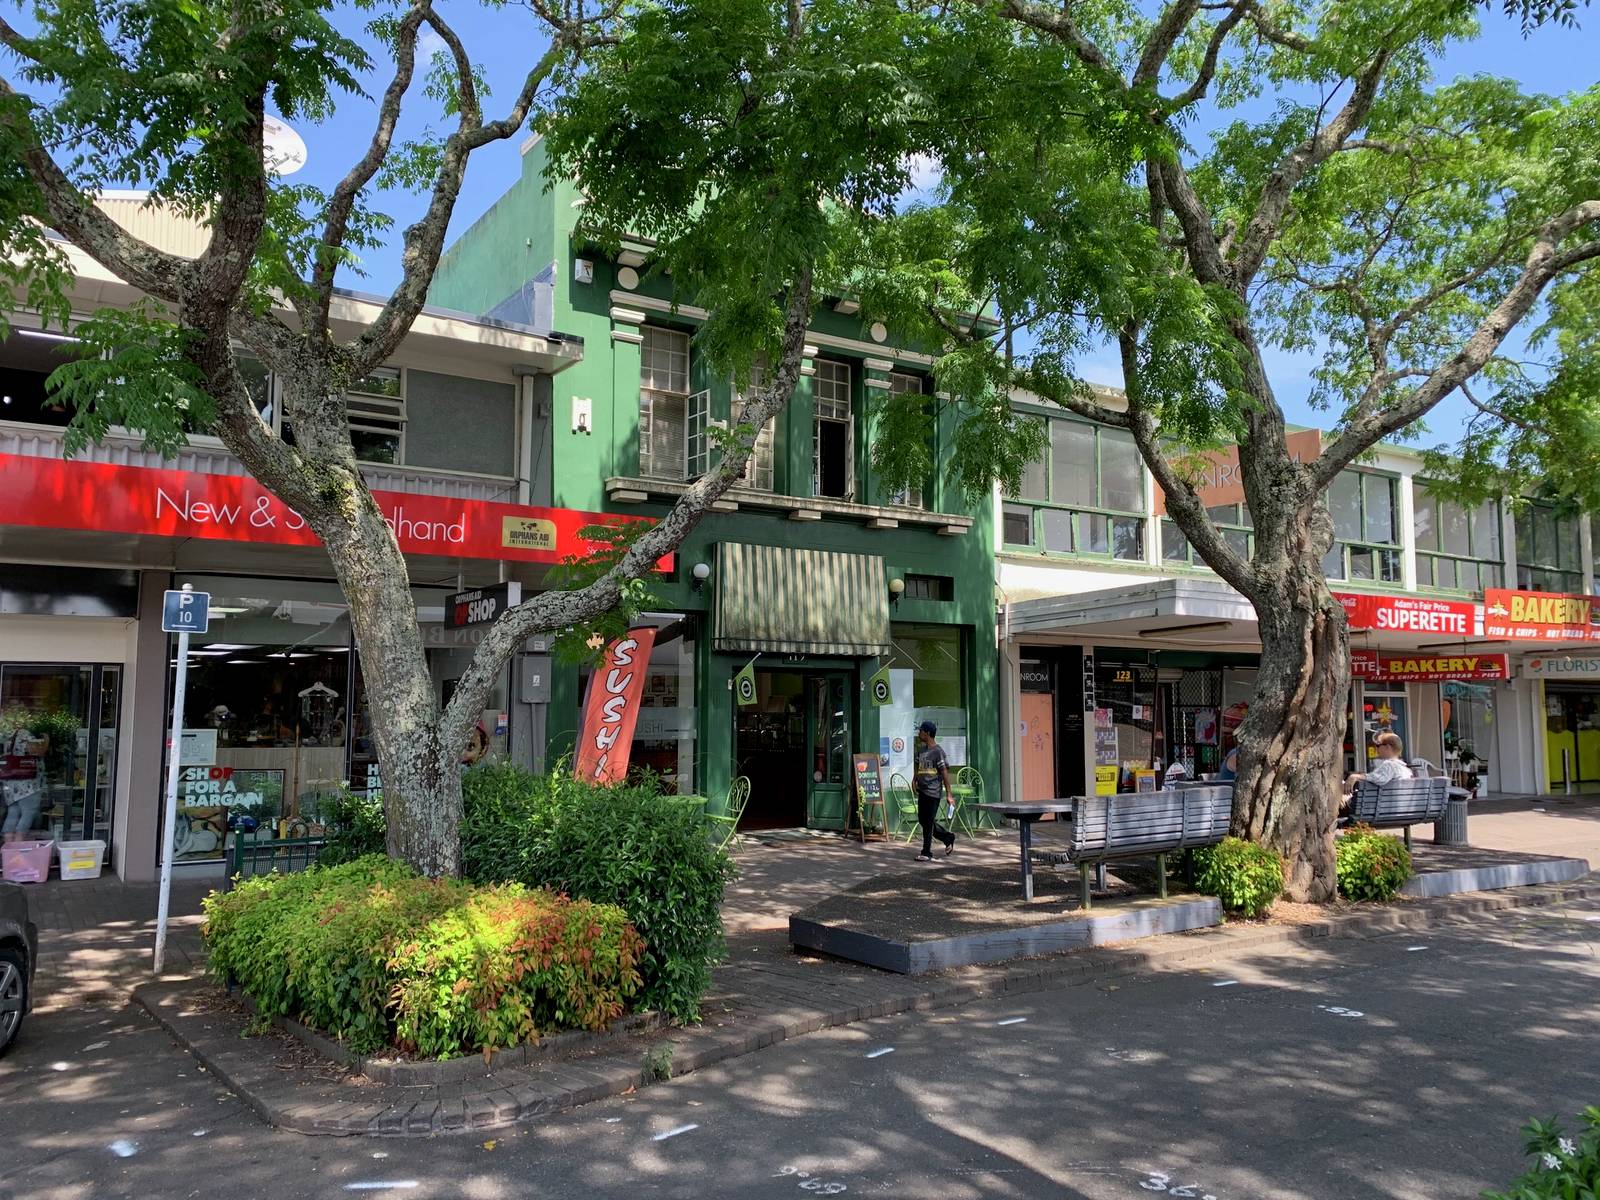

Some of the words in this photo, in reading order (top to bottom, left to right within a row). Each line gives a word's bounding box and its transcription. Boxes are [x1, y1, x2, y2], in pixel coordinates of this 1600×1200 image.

[156, 487, 241, 525] New
[250, 496, 276, 527] &
[509, 530, 538, 540] ORPHANS
[180, 594, 194, 608] P
[1394, 600, 1418, 609] Adam's
[1420, 601, 1432, 610] Fair
[1434, 602, 1450, 612] Price
[180, 611, 192, 622] 10
[468, 598, 497, 623] SHOP
[1511, 595, 1591, 625] BAKERY
[1376, 607, 1467, 633] SUPERETTE
[1488, 626, 1506, 635] FISH
[1508, 627, 1514, 636] &
[1515, 628, 1537, 637] CHIPS
[1546, 629, 1560, 638] HOT
[1561, 629, 1584, 638] BREAD
[1389, 658, 1479, 673] BAKERY
[1020, 672, 1048, 681] NROOM
[1116, 670, 1131, 680] 123
[594, 638, 639, 778] SUSHI
[185, 767, 233, 781] SHOP
[185, 780, 220, 794] FOR
[222, 780, 237, 793] A
